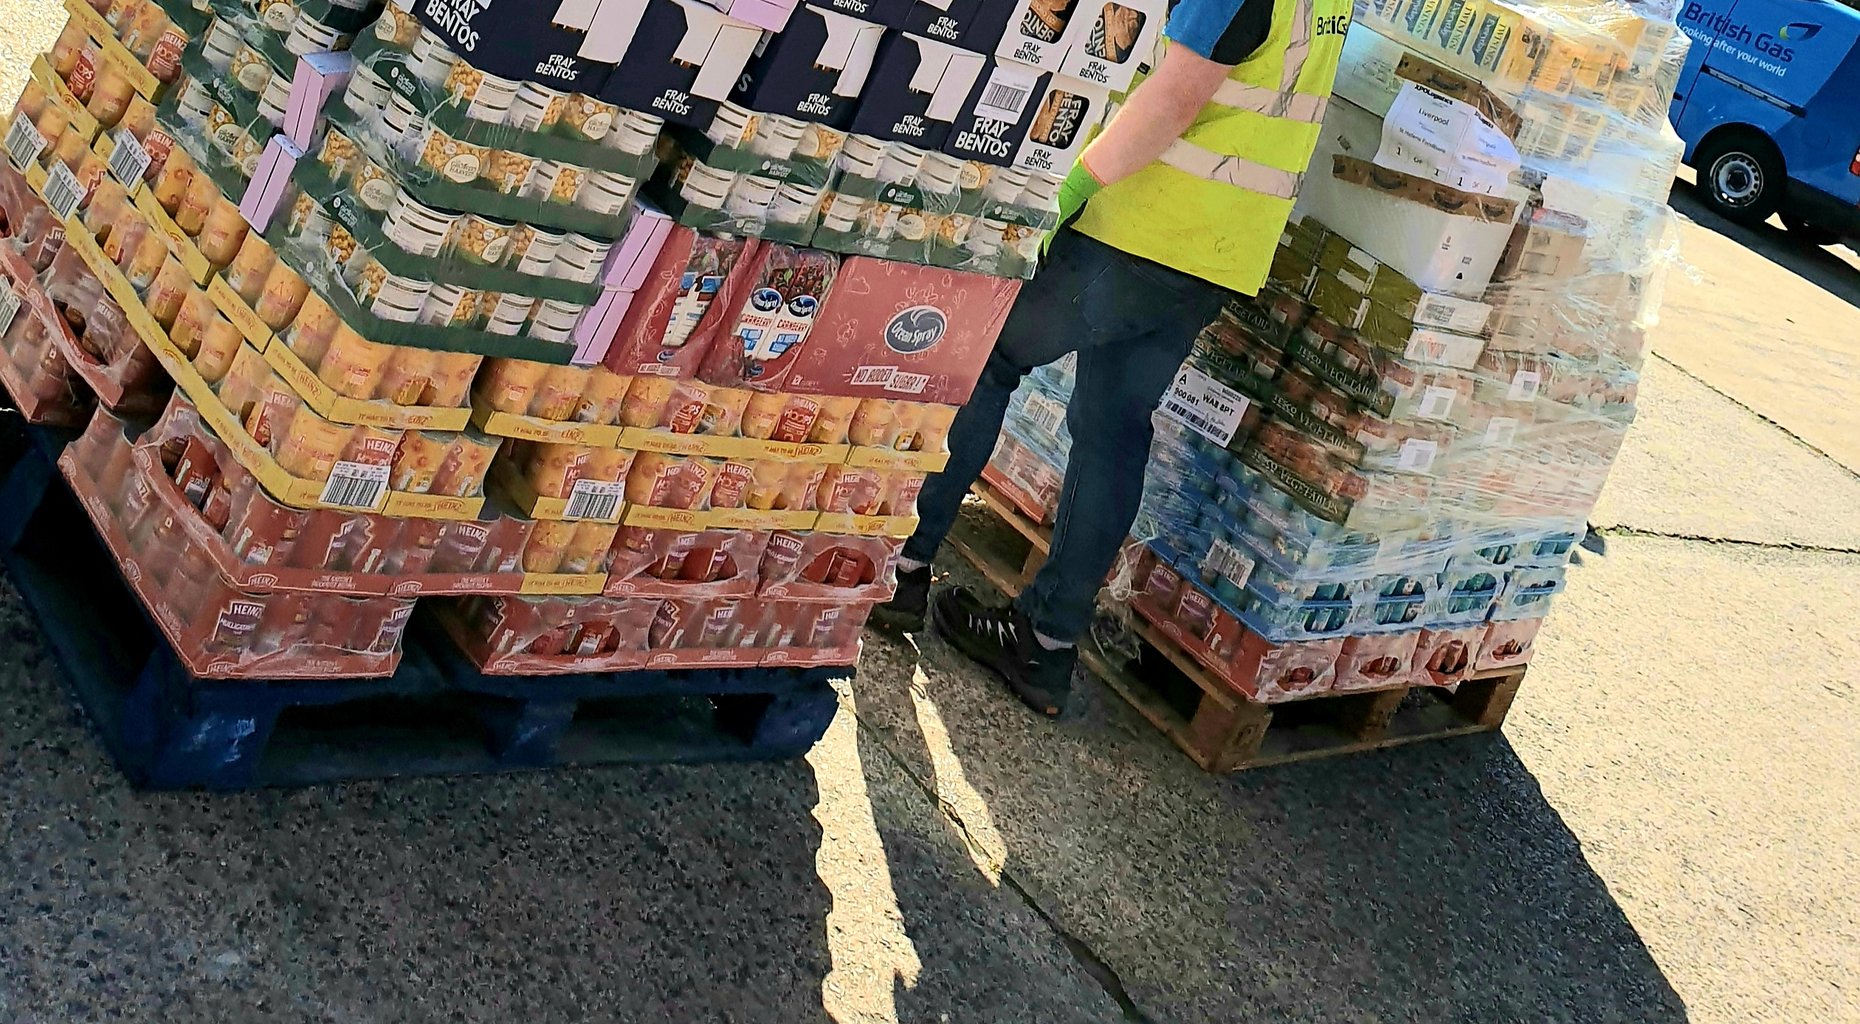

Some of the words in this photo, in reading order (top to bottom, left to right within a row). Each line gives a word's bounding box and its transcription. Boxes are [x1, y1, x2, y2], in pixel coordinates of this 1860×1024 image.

[937, 16, 959, 29] FRAY
[1450, 6, 1474, 50] TWININGS
[926, 23, 960, 41] BENTOS
[1684, 2, 1752, 44] British
[1755, 33, 1795, 63] Gas
[1022, 41, 1041, 55] FRAY
[1483, 23, 1507, 67] TWININGS
[1679, 22, 1713, 46] Looking
[1713, 40, 1736, 55] after
[1736, 49, 1758, 64] your
[1758, 59, 1787, 77] world
[549, 55, 576, 69] FRAY
[1013, 48, 1042, 64] BENTOS
[535, 62, 579, 81] BENTOS
[1079, 68, 1109, 84] BENTOS
[1088, 61, 1108, 75] FRAY
[664, 89, 689, 103] FRAY
[807, 93, 830, 106] FRAY
[652, 96, 691, 116] BENTOS
[797, 101, 832, 116] BENTOS
[902, 114, 924, 127] FRAY
[1418, 107, 1450, 126] Liverpool
[892, 122, 925, 137] BENTOS
[972, 117, 1011, 138] FRAY
[954, 131, 1013, 158] BENTOS
[1024, 156, 1053, 170] BENTOS
[1033, 148, 1052, 162] FRAY
[891, 321, 912, 347] Ocean
[912, 325, 939, 347] Spray
[1299, 344, 1322, 366] TESCO
[854, 368, 866, 383] NO
[867, 368, 893, 383] ADDED
[1178, 374, 1187, 386] A
[1272, 394, 1297, 416] TESCO
[784, 409, 812, 425] HOOPS
[1252, 449, 1278, 472] TESCO
[1280, 469, 1339, 515] VEGETABLES
[777, 537, 801, 553] HEINZ
